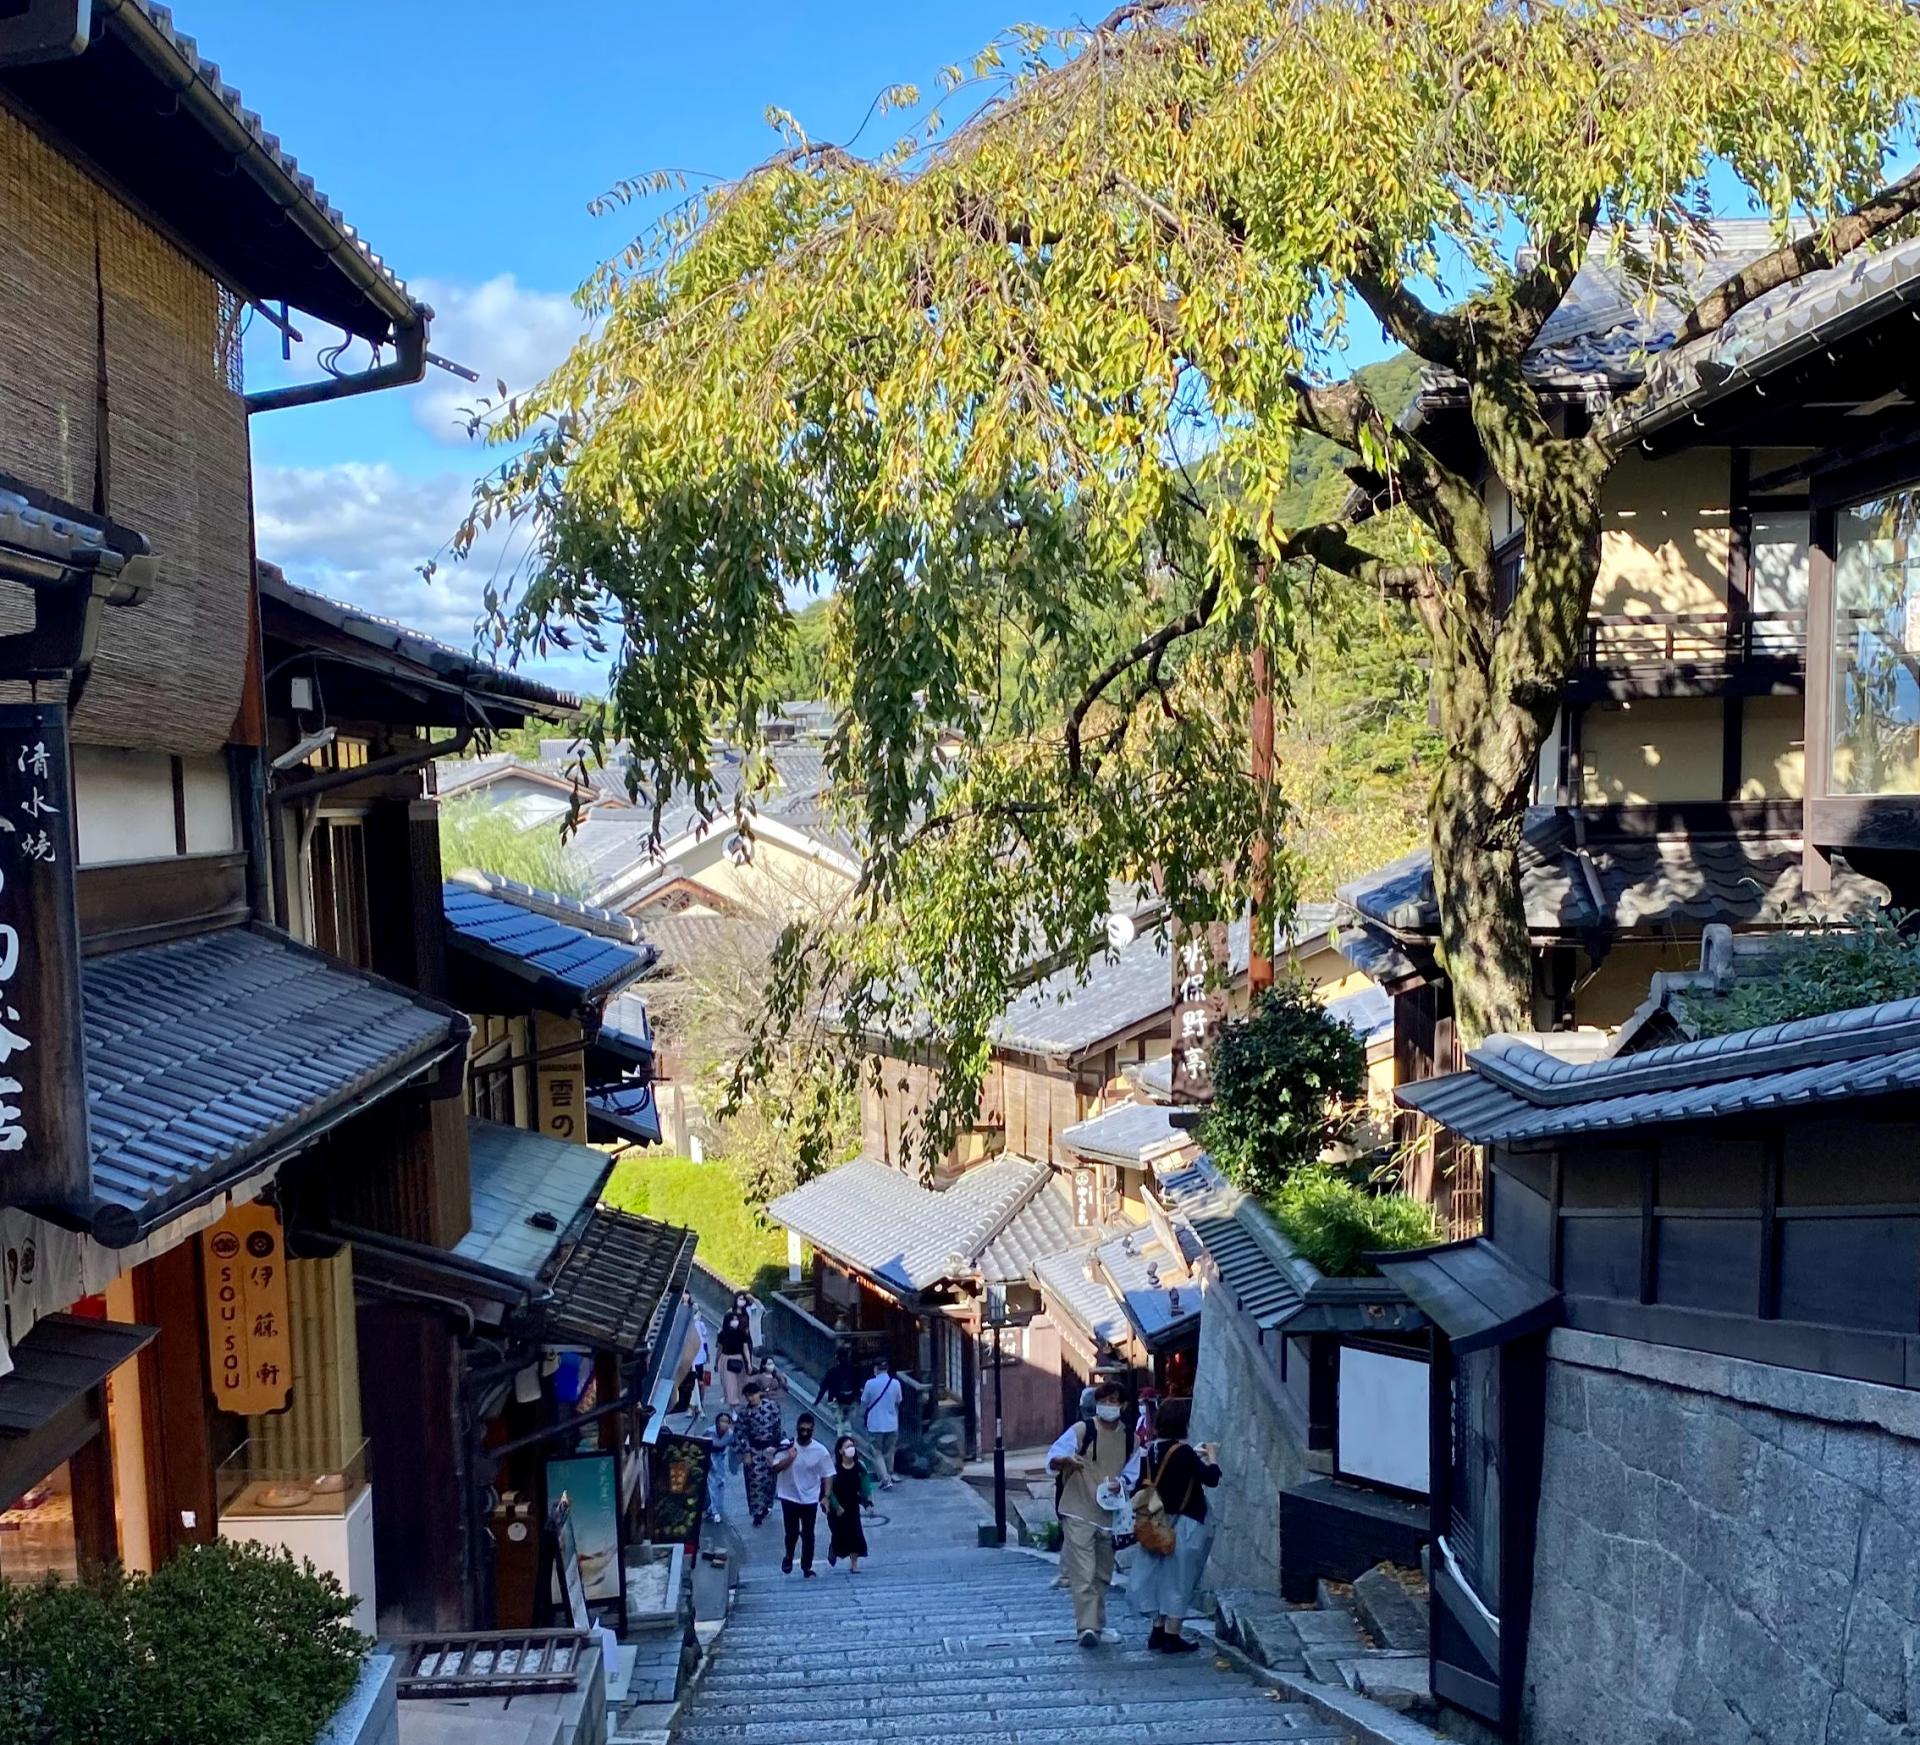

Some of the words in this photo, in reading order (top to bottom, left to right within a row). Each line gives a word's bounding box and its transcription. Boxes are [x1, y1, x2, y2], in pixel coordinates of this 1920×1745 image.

[18, 741, 60, 862] 清水焼
[550, 1079, 574, 1137] 雲の
[251, 1265, 280, 1385] 伊藤軒
